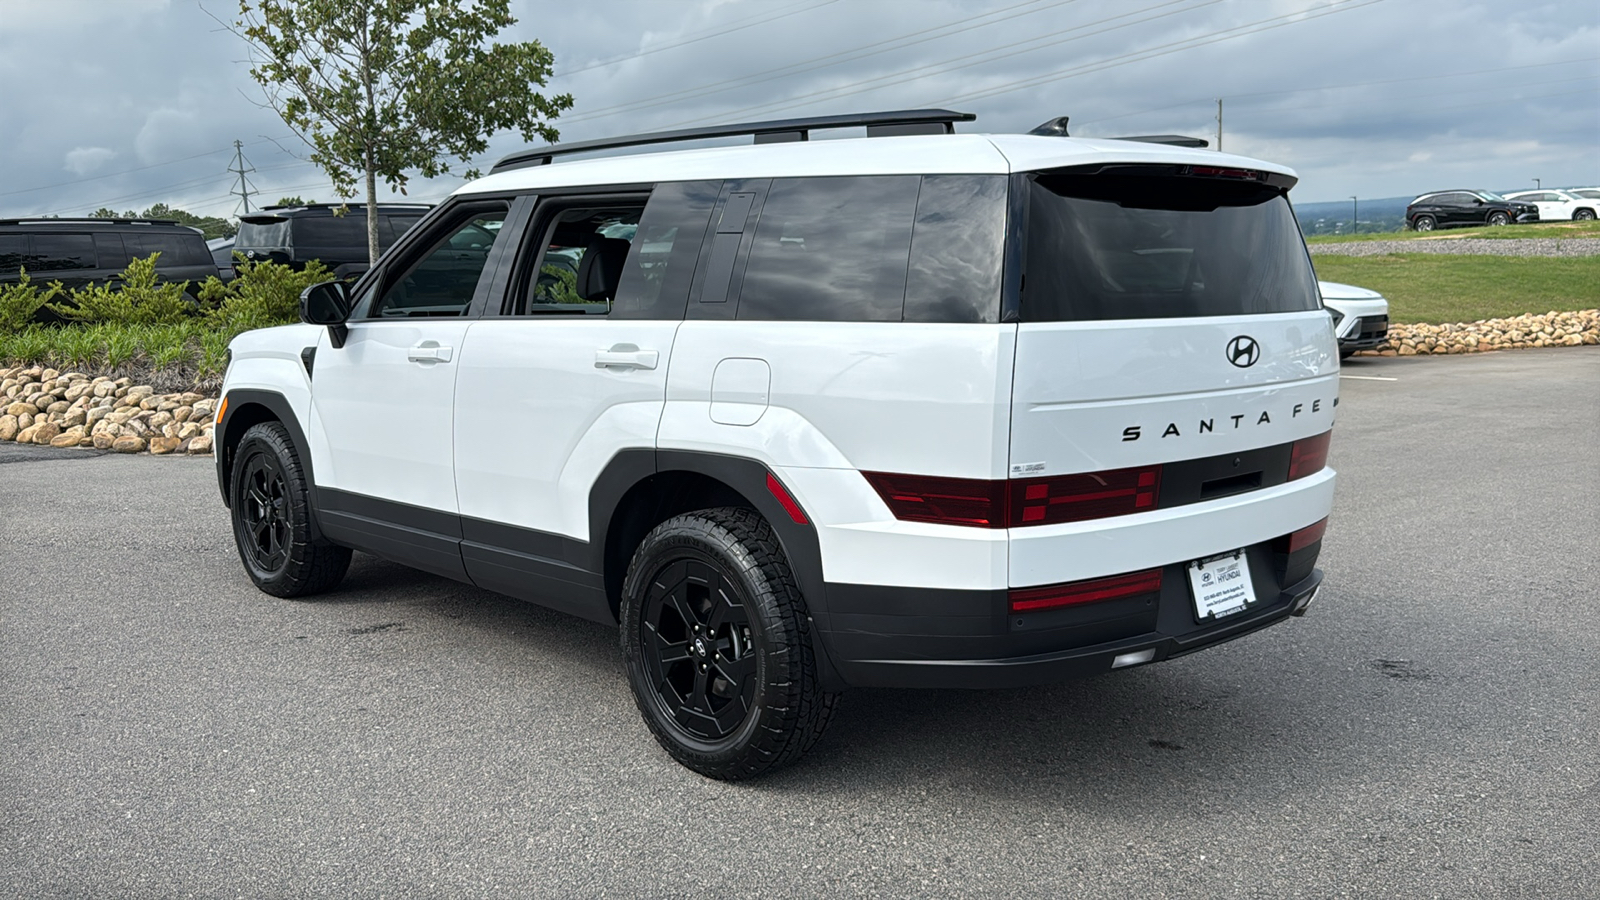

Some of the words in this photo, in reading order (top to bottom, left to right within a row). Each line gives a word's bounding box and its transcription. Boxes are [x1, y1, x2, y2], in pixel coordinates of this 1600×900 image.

[1121, 411, 1271, 442] SANTA
[1292, 399, 1321, 418] FE
[1217, 570, 1241, 583] HYUNDAI
